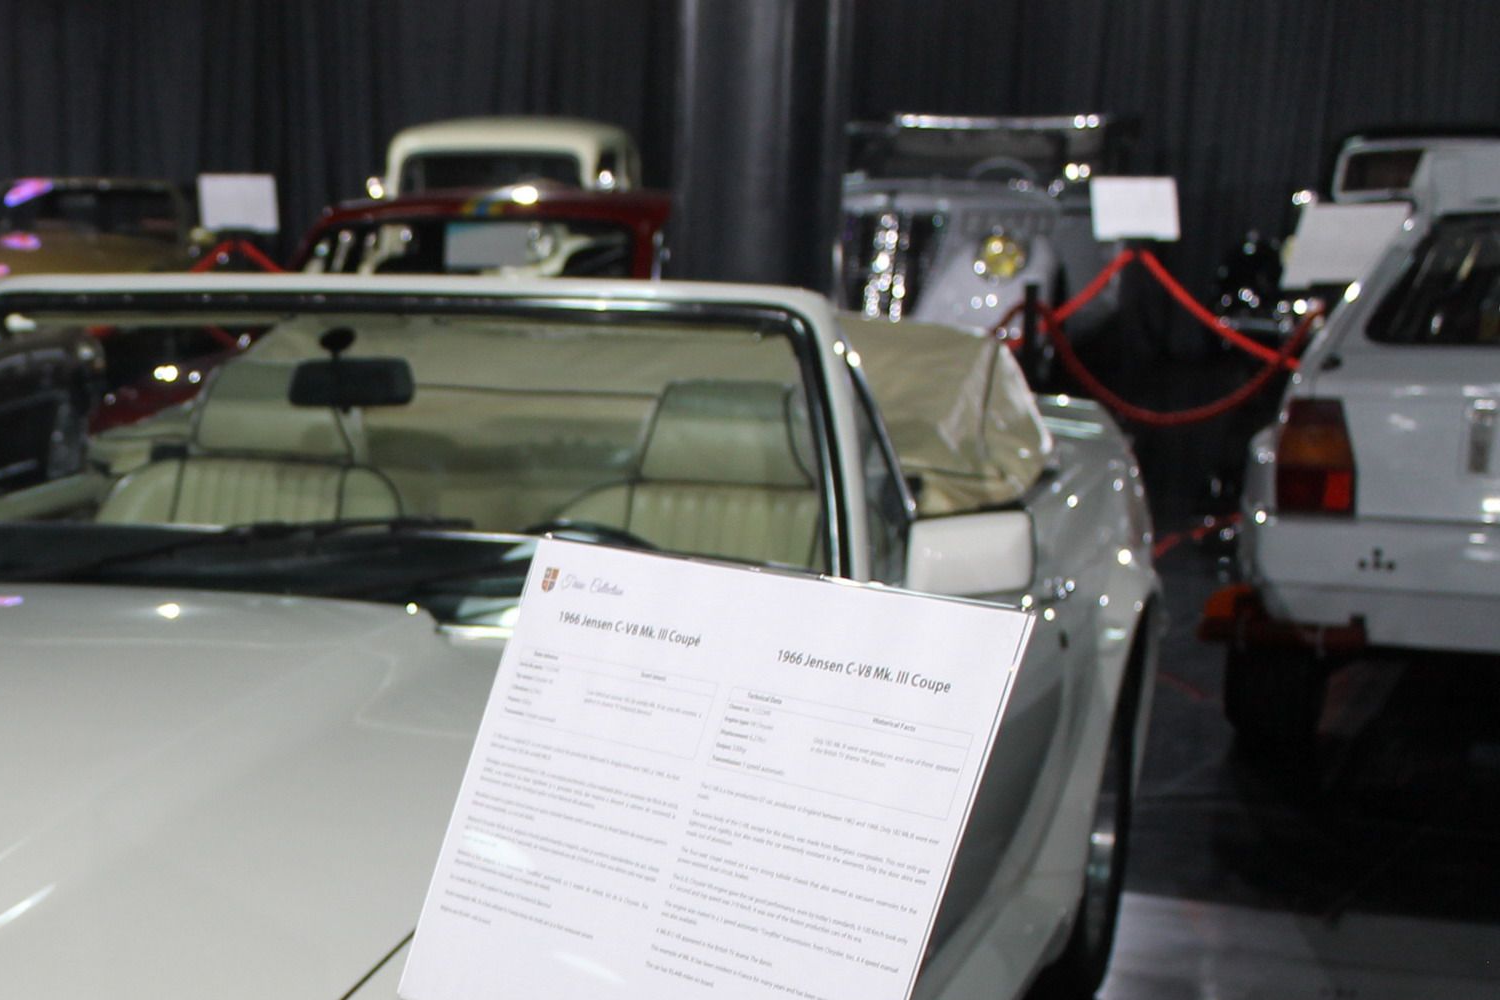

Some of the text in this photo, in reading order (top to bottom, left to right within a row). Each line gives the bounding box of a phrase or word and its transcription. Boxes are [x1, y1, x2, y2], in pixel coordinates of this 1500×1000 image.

[559, 611, 701, 648] 1966 Jensen C-V8 Mk. III Coupé
[776, 649, 952, 695] 1966 Jensen C-V8 Mk. III Coupe
[899, 722, 917, 732] Facts
